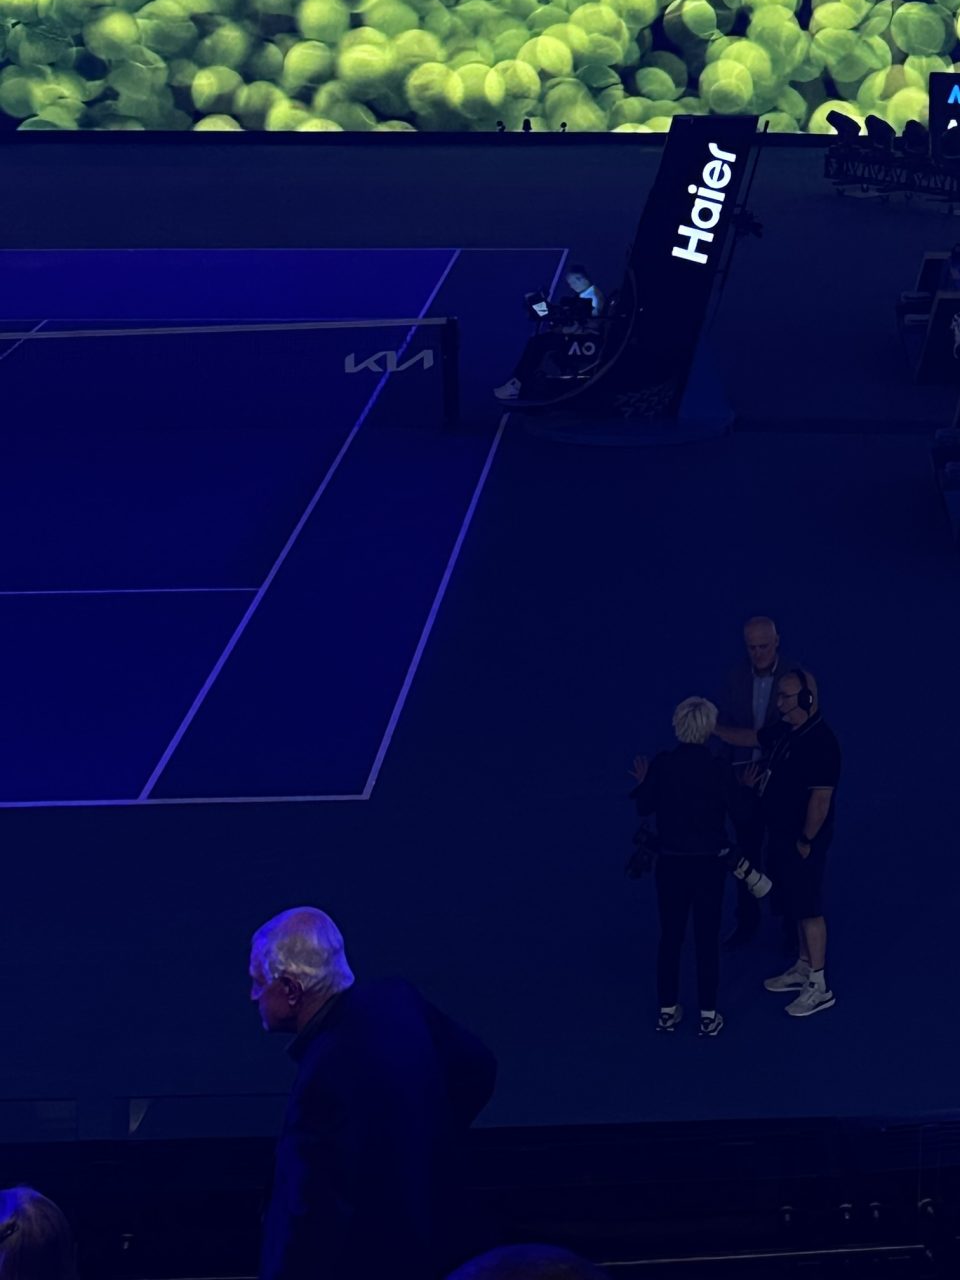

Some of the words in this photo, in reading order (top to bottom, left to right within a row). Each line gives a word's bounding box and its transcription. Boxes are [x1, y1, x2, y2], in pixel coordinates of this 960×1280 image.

[671, 142, 737, 264] Haier
[567, 341, 596, 356] AO
[344, 349, 434, 373] KIA
